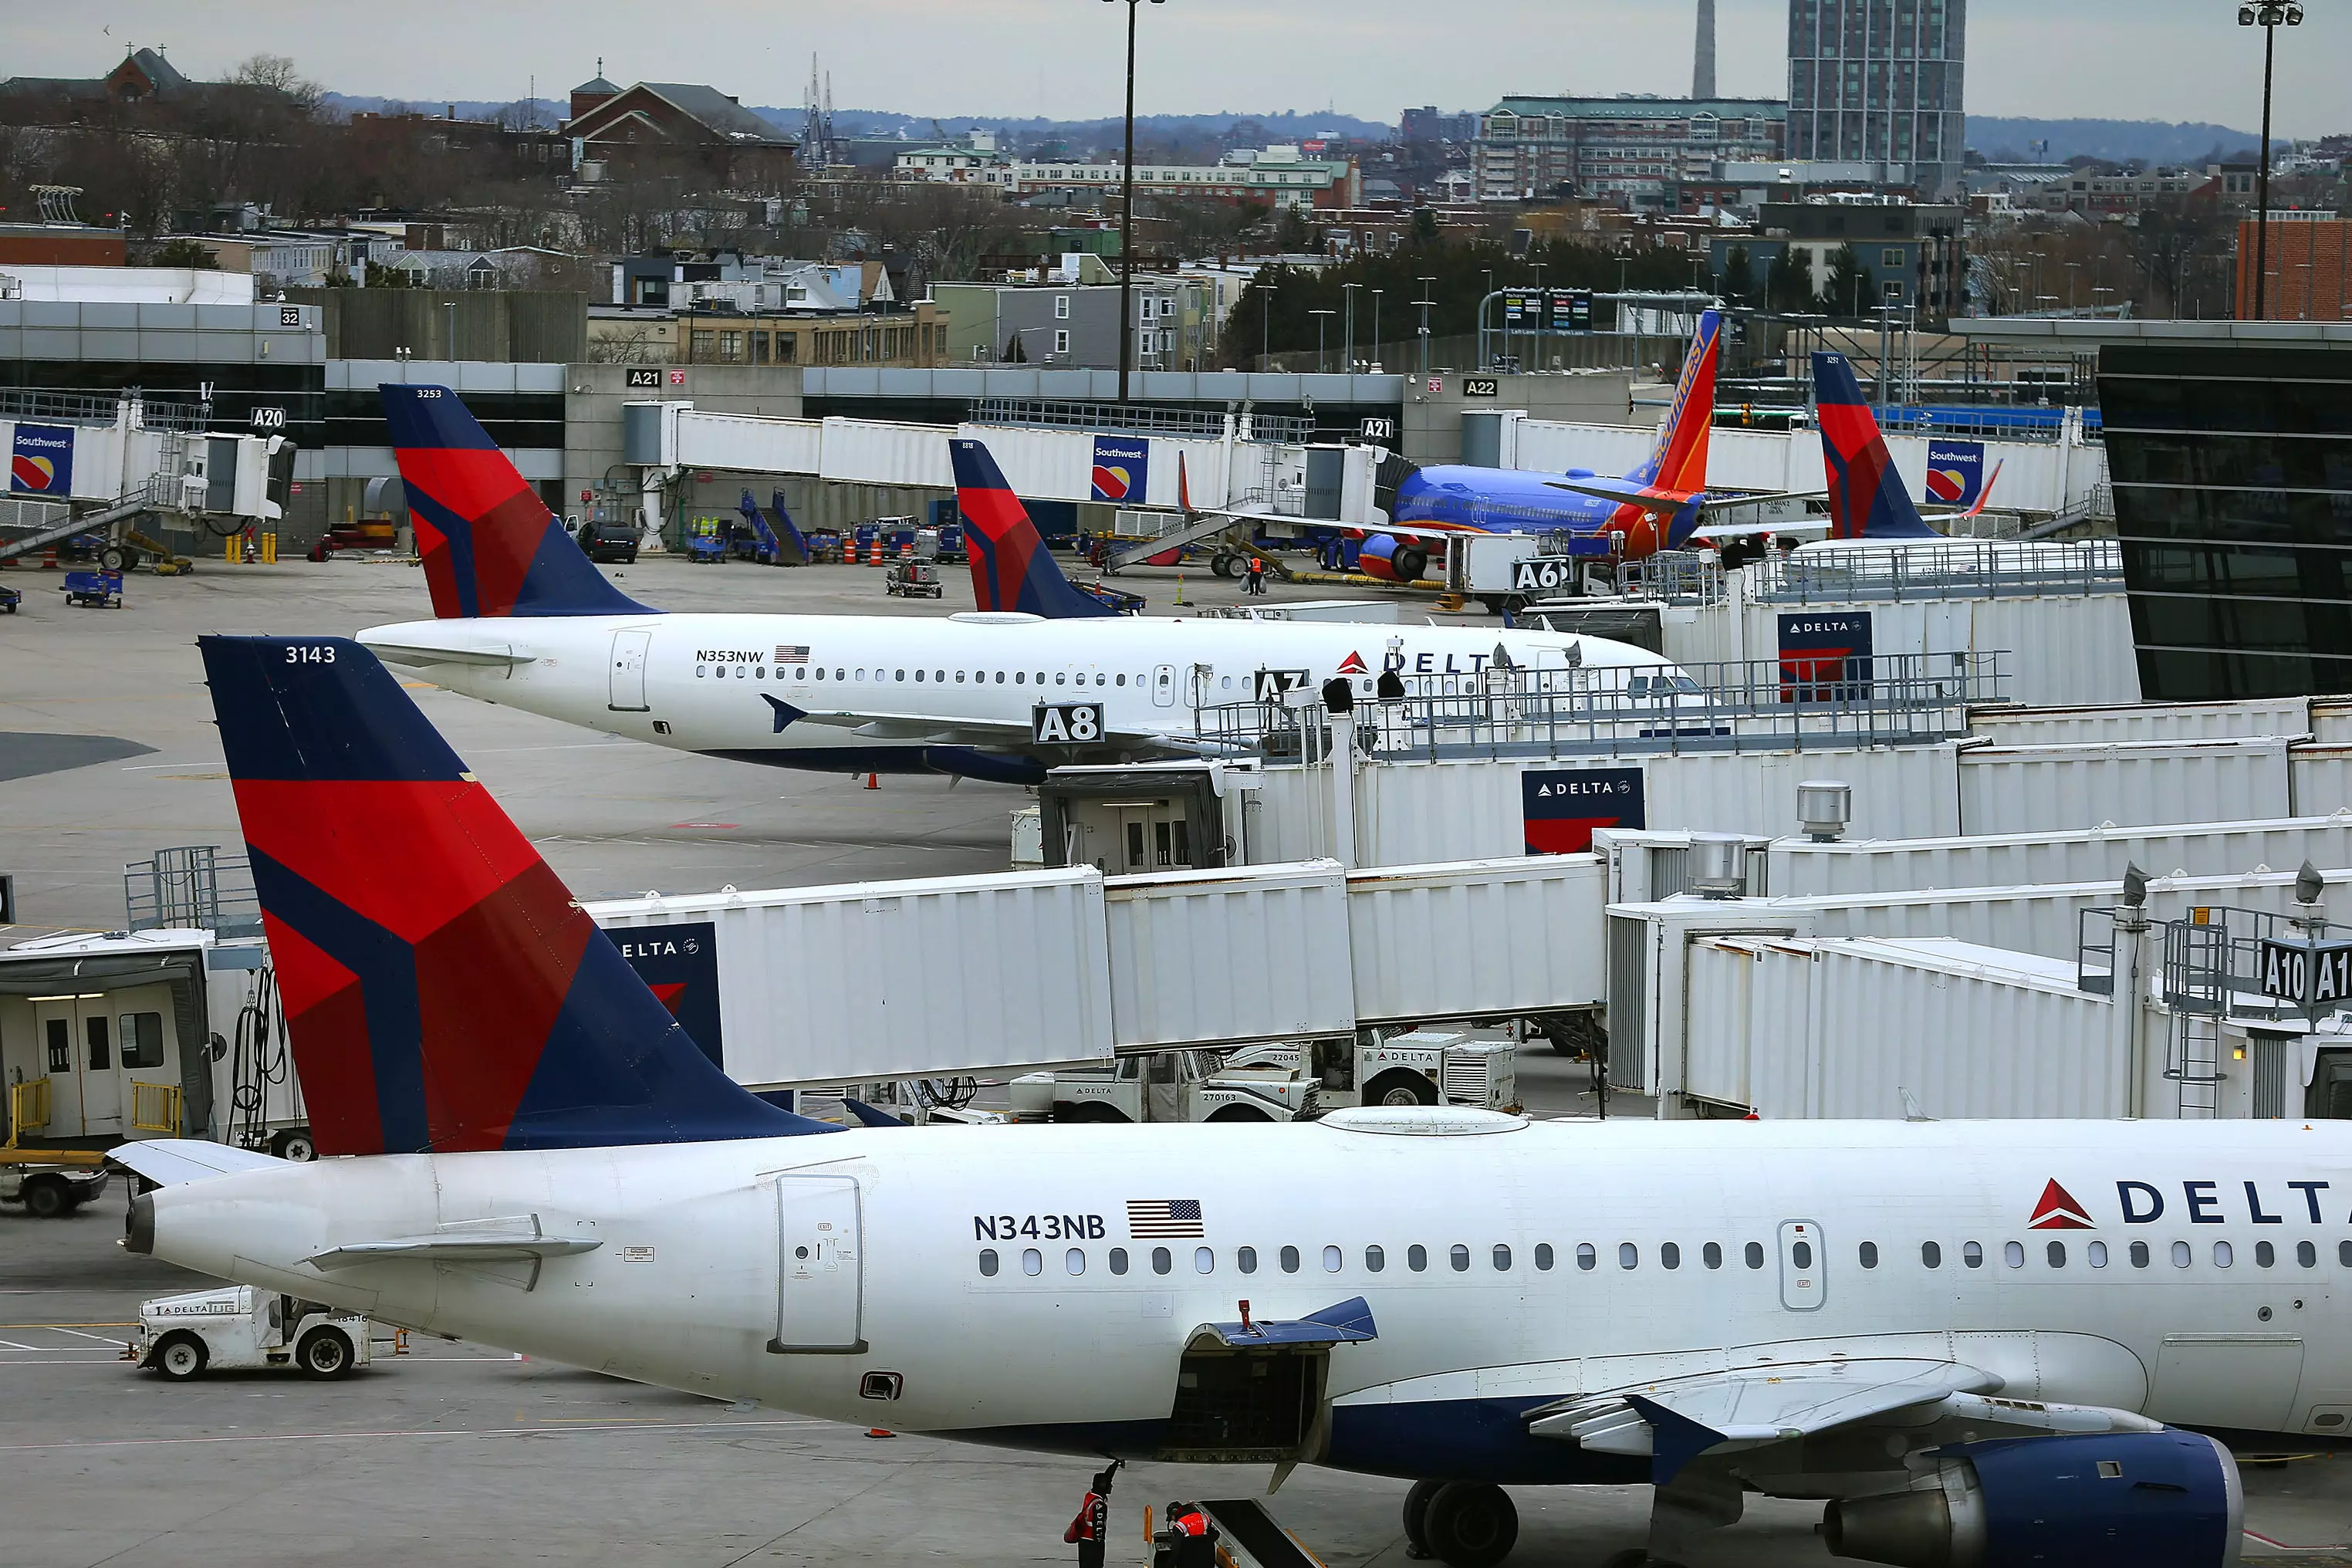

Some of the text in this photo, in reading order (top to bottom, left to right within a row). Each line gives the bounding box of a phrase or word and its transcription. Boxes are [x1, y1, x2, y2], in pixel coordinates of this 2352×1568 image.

[282, 313, 298, 323] 32
[631, 372, 659, 384] A21
[417, 390, 441, 398] 3253
[1467, 381, 1495, 394] A22
[1654, 327, 1705, 468] SOUTHWEST
[254, 409, 282, 427] A20
[1365, 421, 1390, 438] A21
[16, 436, 66, 448] Southwest
[1096, 448, 1142, 459] Southwest
[1930, 451, 1977, 463] Southwest
[1516, 563, 1558, 589] A6
[1804, 622, 1848, 632] DELTA
[286, 647, 335, 663] 3143
[697, 650, 763, 663] N353NW
[1259, 673, 1303, 701] A7
[1039, 707, 1097, 741] A8
[1556, 782, 1613, 795] DELTA
[622, 941, 677, 958] ELTA
[2265, 948, 2305, 1000] A10
[2316, 952, 2352, 1000] A1
[1391, 1053, 1433, 1062] DELTA
[2116, 1181, 2352, 1224] DELT
[974, 1215, 1106, 1241] N343NB
[206, 1301, 235, 1313] TUG
